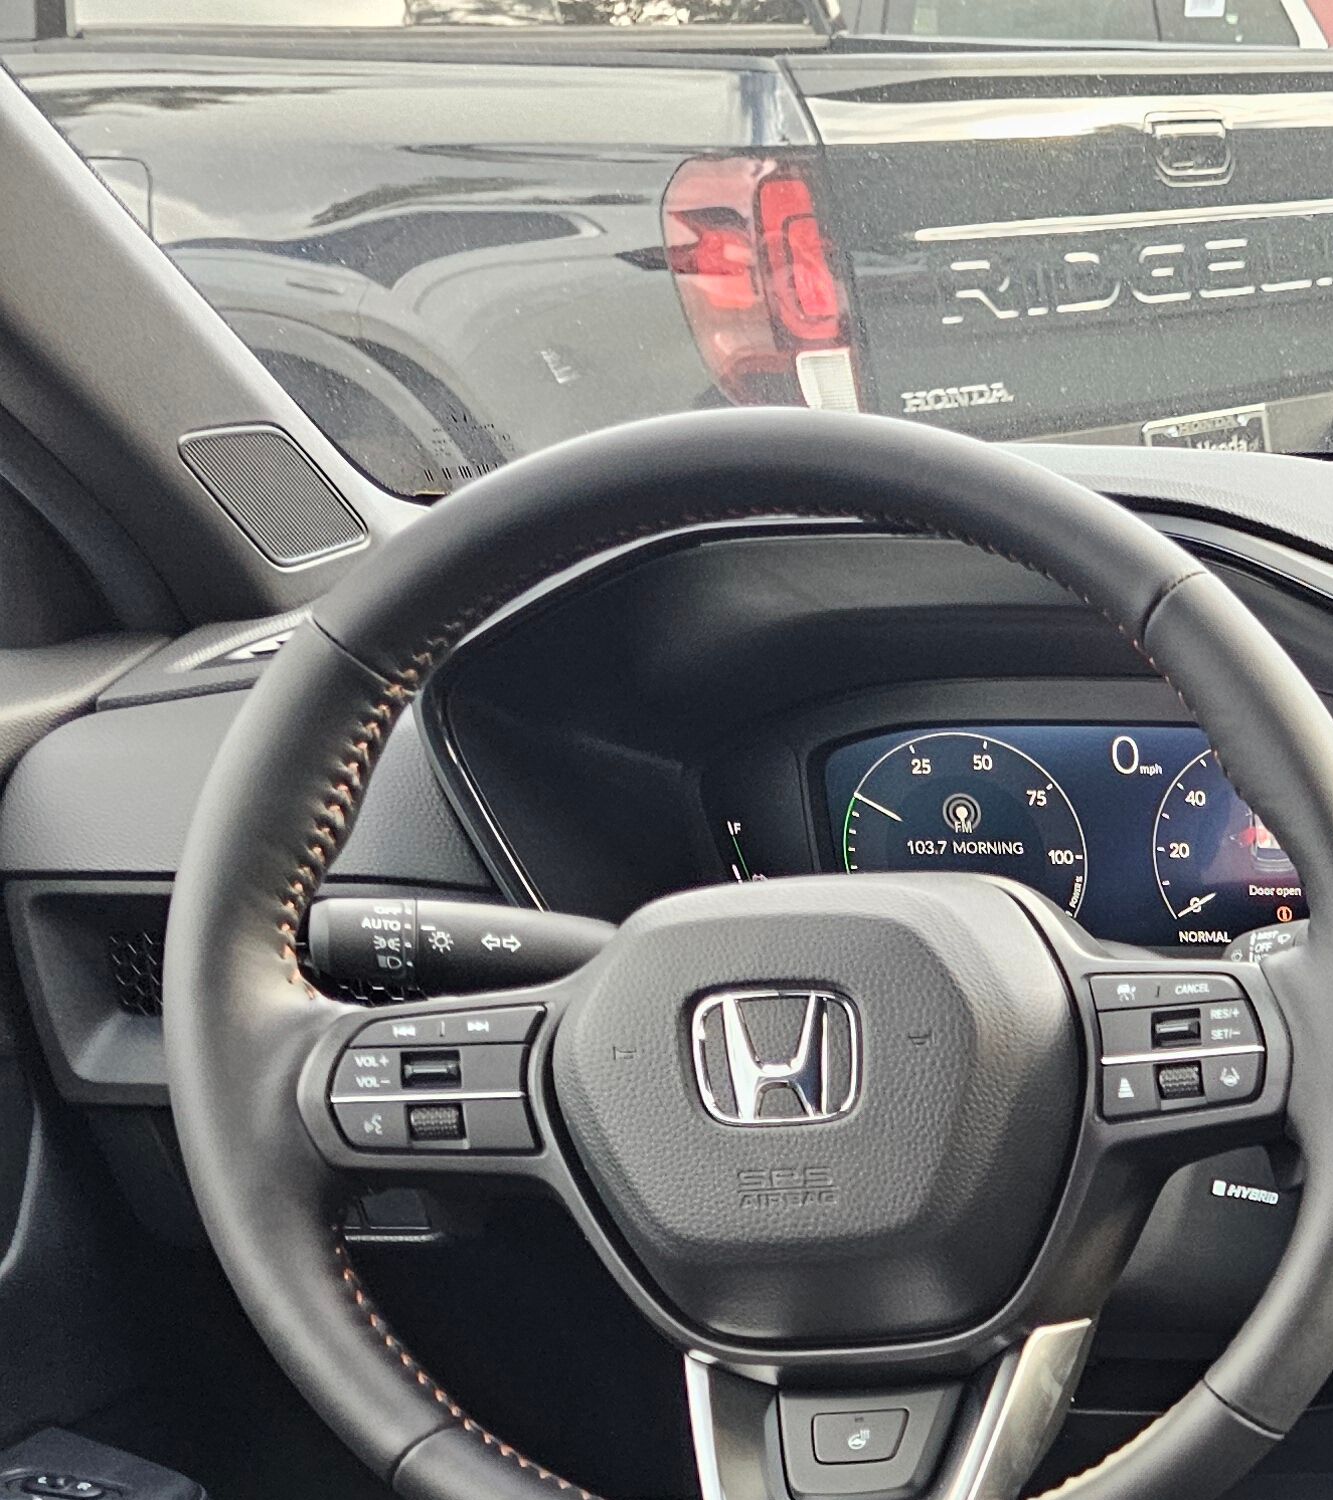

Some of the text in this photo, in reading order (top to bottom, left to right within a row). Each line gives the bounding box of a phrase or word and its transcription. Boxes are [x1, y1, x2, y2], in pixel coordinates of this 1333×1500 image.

[901, 383, 1014, 412] HONDA
[973, 754, 993, 771] 50
[1112, 735, 1163, 776] 0 mph
[911, 758, 931, 775] 25
[1026, 789, 1047, 807] 75
[1185, 790, 1206, 807] 40
[954, 821, 973, 834] FM
[907, 840, 1024, 855] 103.7 MORNING
[1169, 842, 1190, 858] 20
[1047, 849, 1074, 865] 100
[1248, 884, 1302, 898] Door open
[361, 917, 401, 931] AUTO
[1178, 930, 1232, 943] NORMAL
[1254, 942, 1273, 953] OFF
[1174, 983, 1210, 995] CANCEL
[1210, 1007, 1240, 1020] RES/+
[1226, 1183, 1279, 1205] HYBRID
